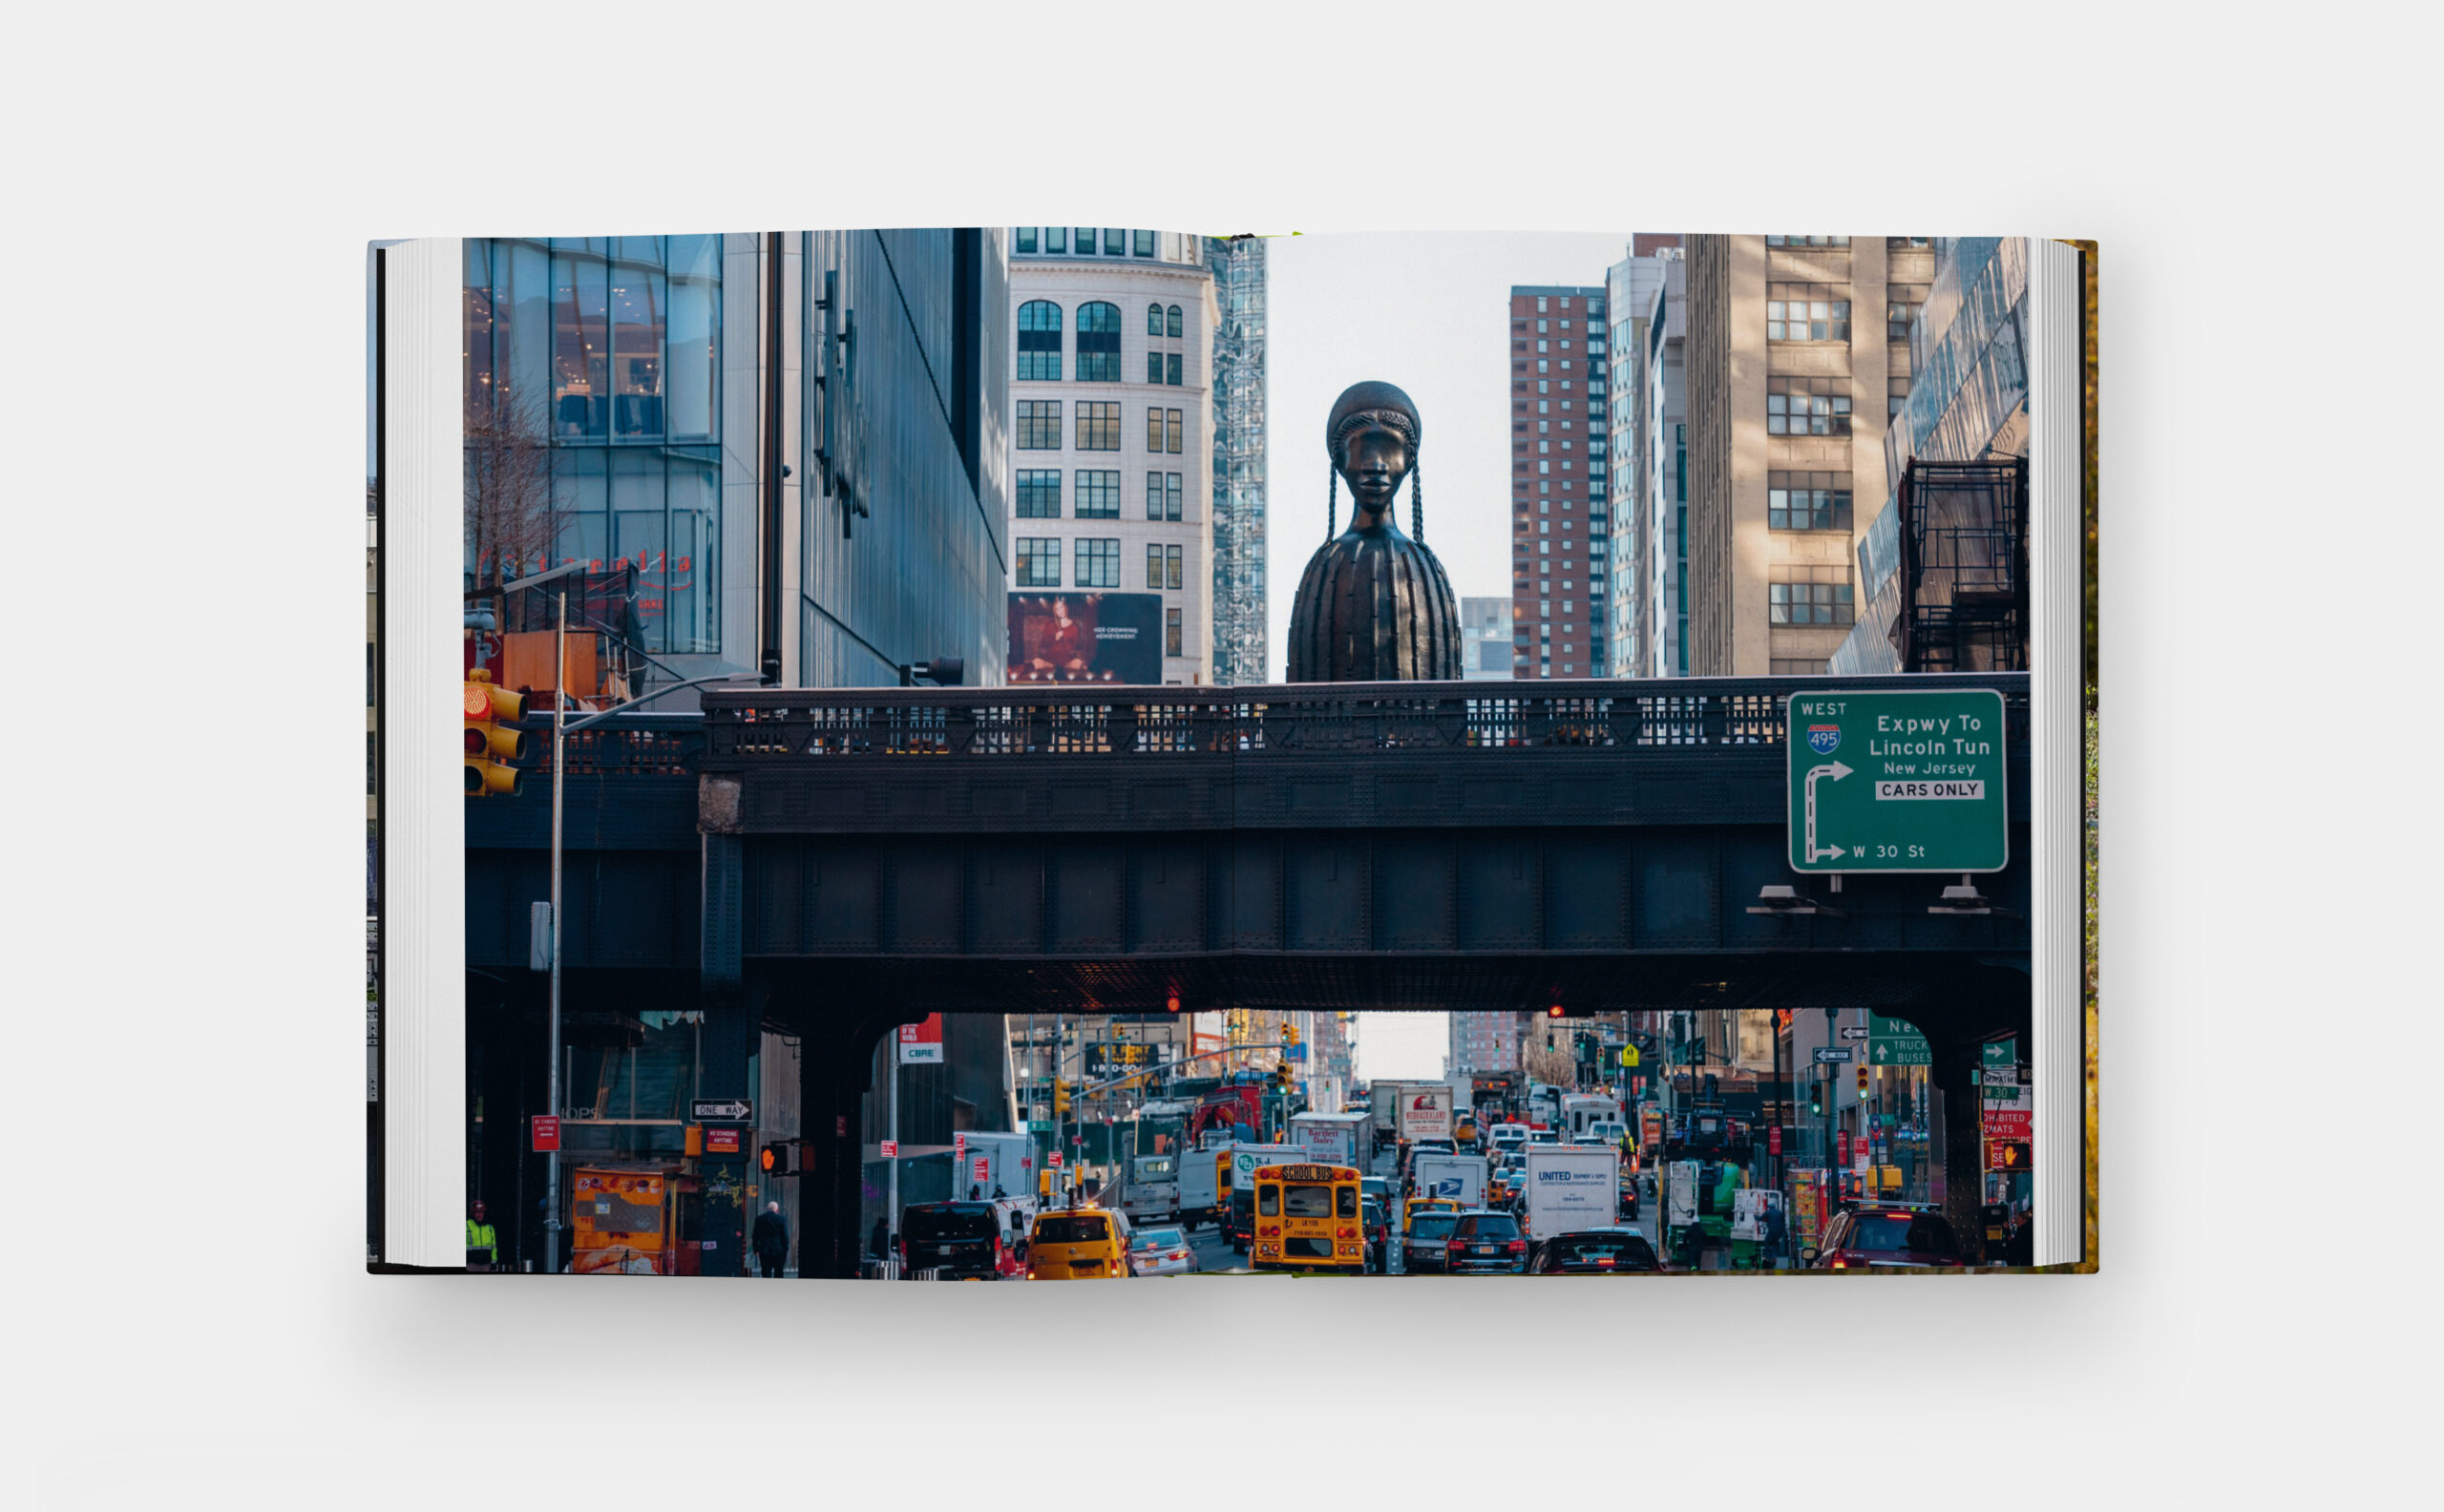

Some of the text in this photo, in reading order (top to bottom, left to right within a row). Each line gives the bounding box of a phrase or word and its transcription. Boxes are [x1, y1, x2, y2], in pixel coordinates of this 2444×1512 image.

[1801, 703, 1846, 716] WEST
[1878, 714, 1981, 735] Expwy To
[1810, 732, 1838, 746] 495
[1870, 739, 1991, 756] Lincoln Tun
[1885, 762, 1976, 777] New Jersey
[1882, 783, 1978, 797] CARS ONLY
[1853, 846, 1925, 858] W 30 St
[1894, 1040, 1928, 1050] TRUCK
[908, 1049, 935, 1058] CBRE
[1995, 1087, 2008, 1098] 30
[700, 1106, 743, 1115] ONE WAY
[1308, 1128, 1338, 1137] Bartlett
[1314, 1137, 1334, 1145] Dairy
[1283, 1166, 1333, 1180] SCHOOL BUS
[1539, 1171, 1571, 1181] UNITED
